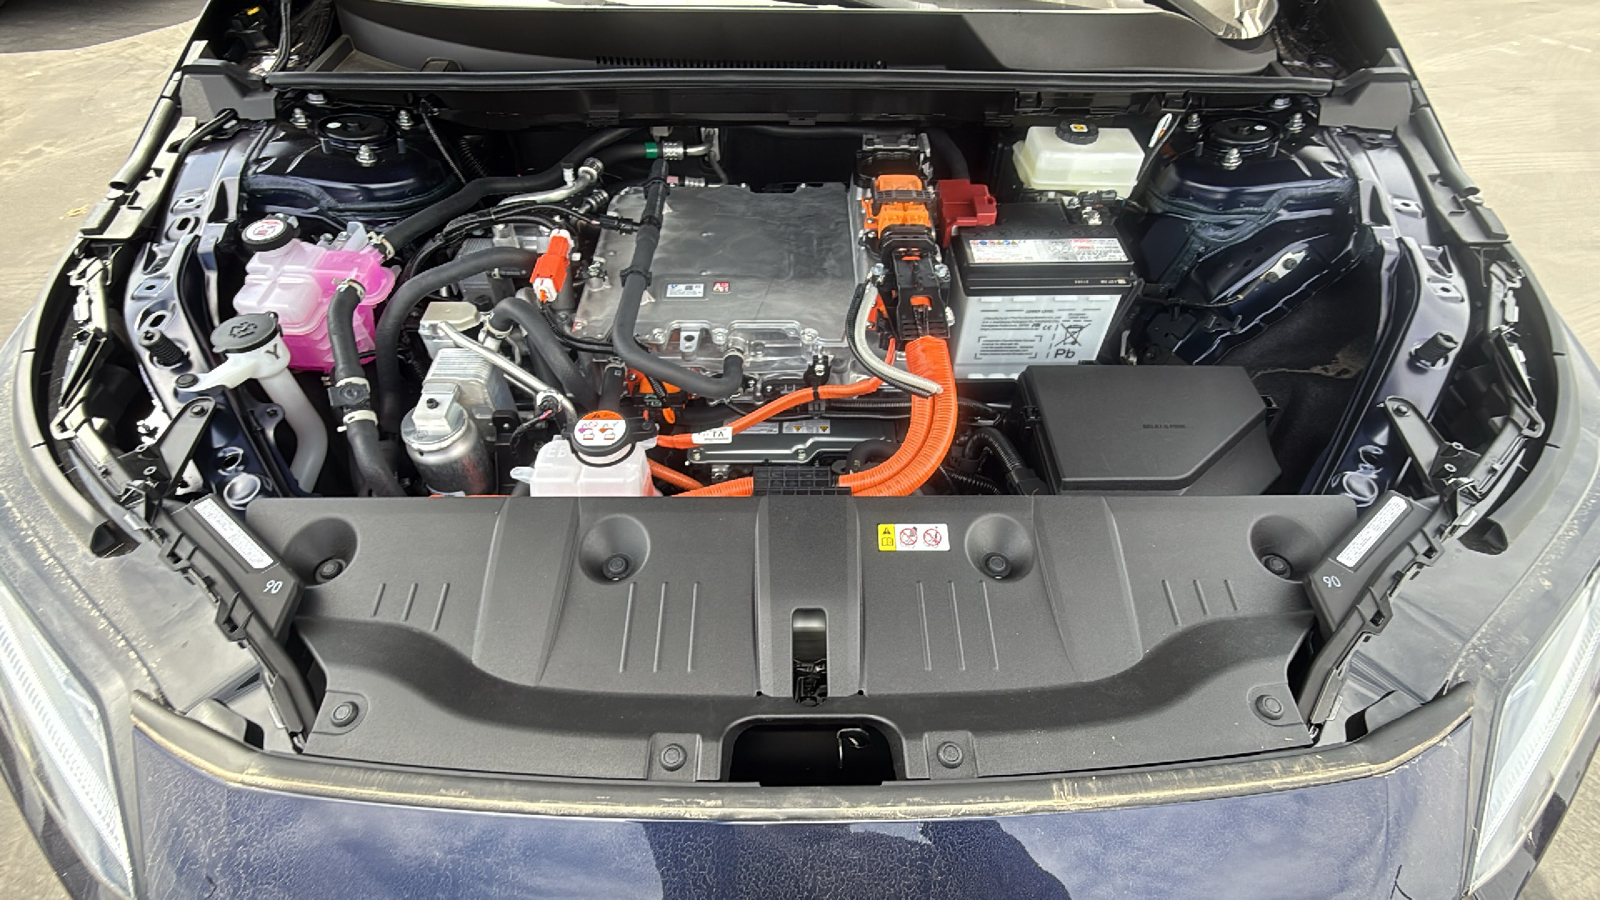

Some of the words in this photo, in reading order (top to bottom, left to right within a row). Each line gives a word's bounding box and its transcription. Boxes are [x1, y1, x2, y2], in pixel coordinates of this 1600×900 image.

[1054, 348, 1075, 359] Pb
[263, 579, 283, 594] 90
[1322, 575, 1341, 588] 90
